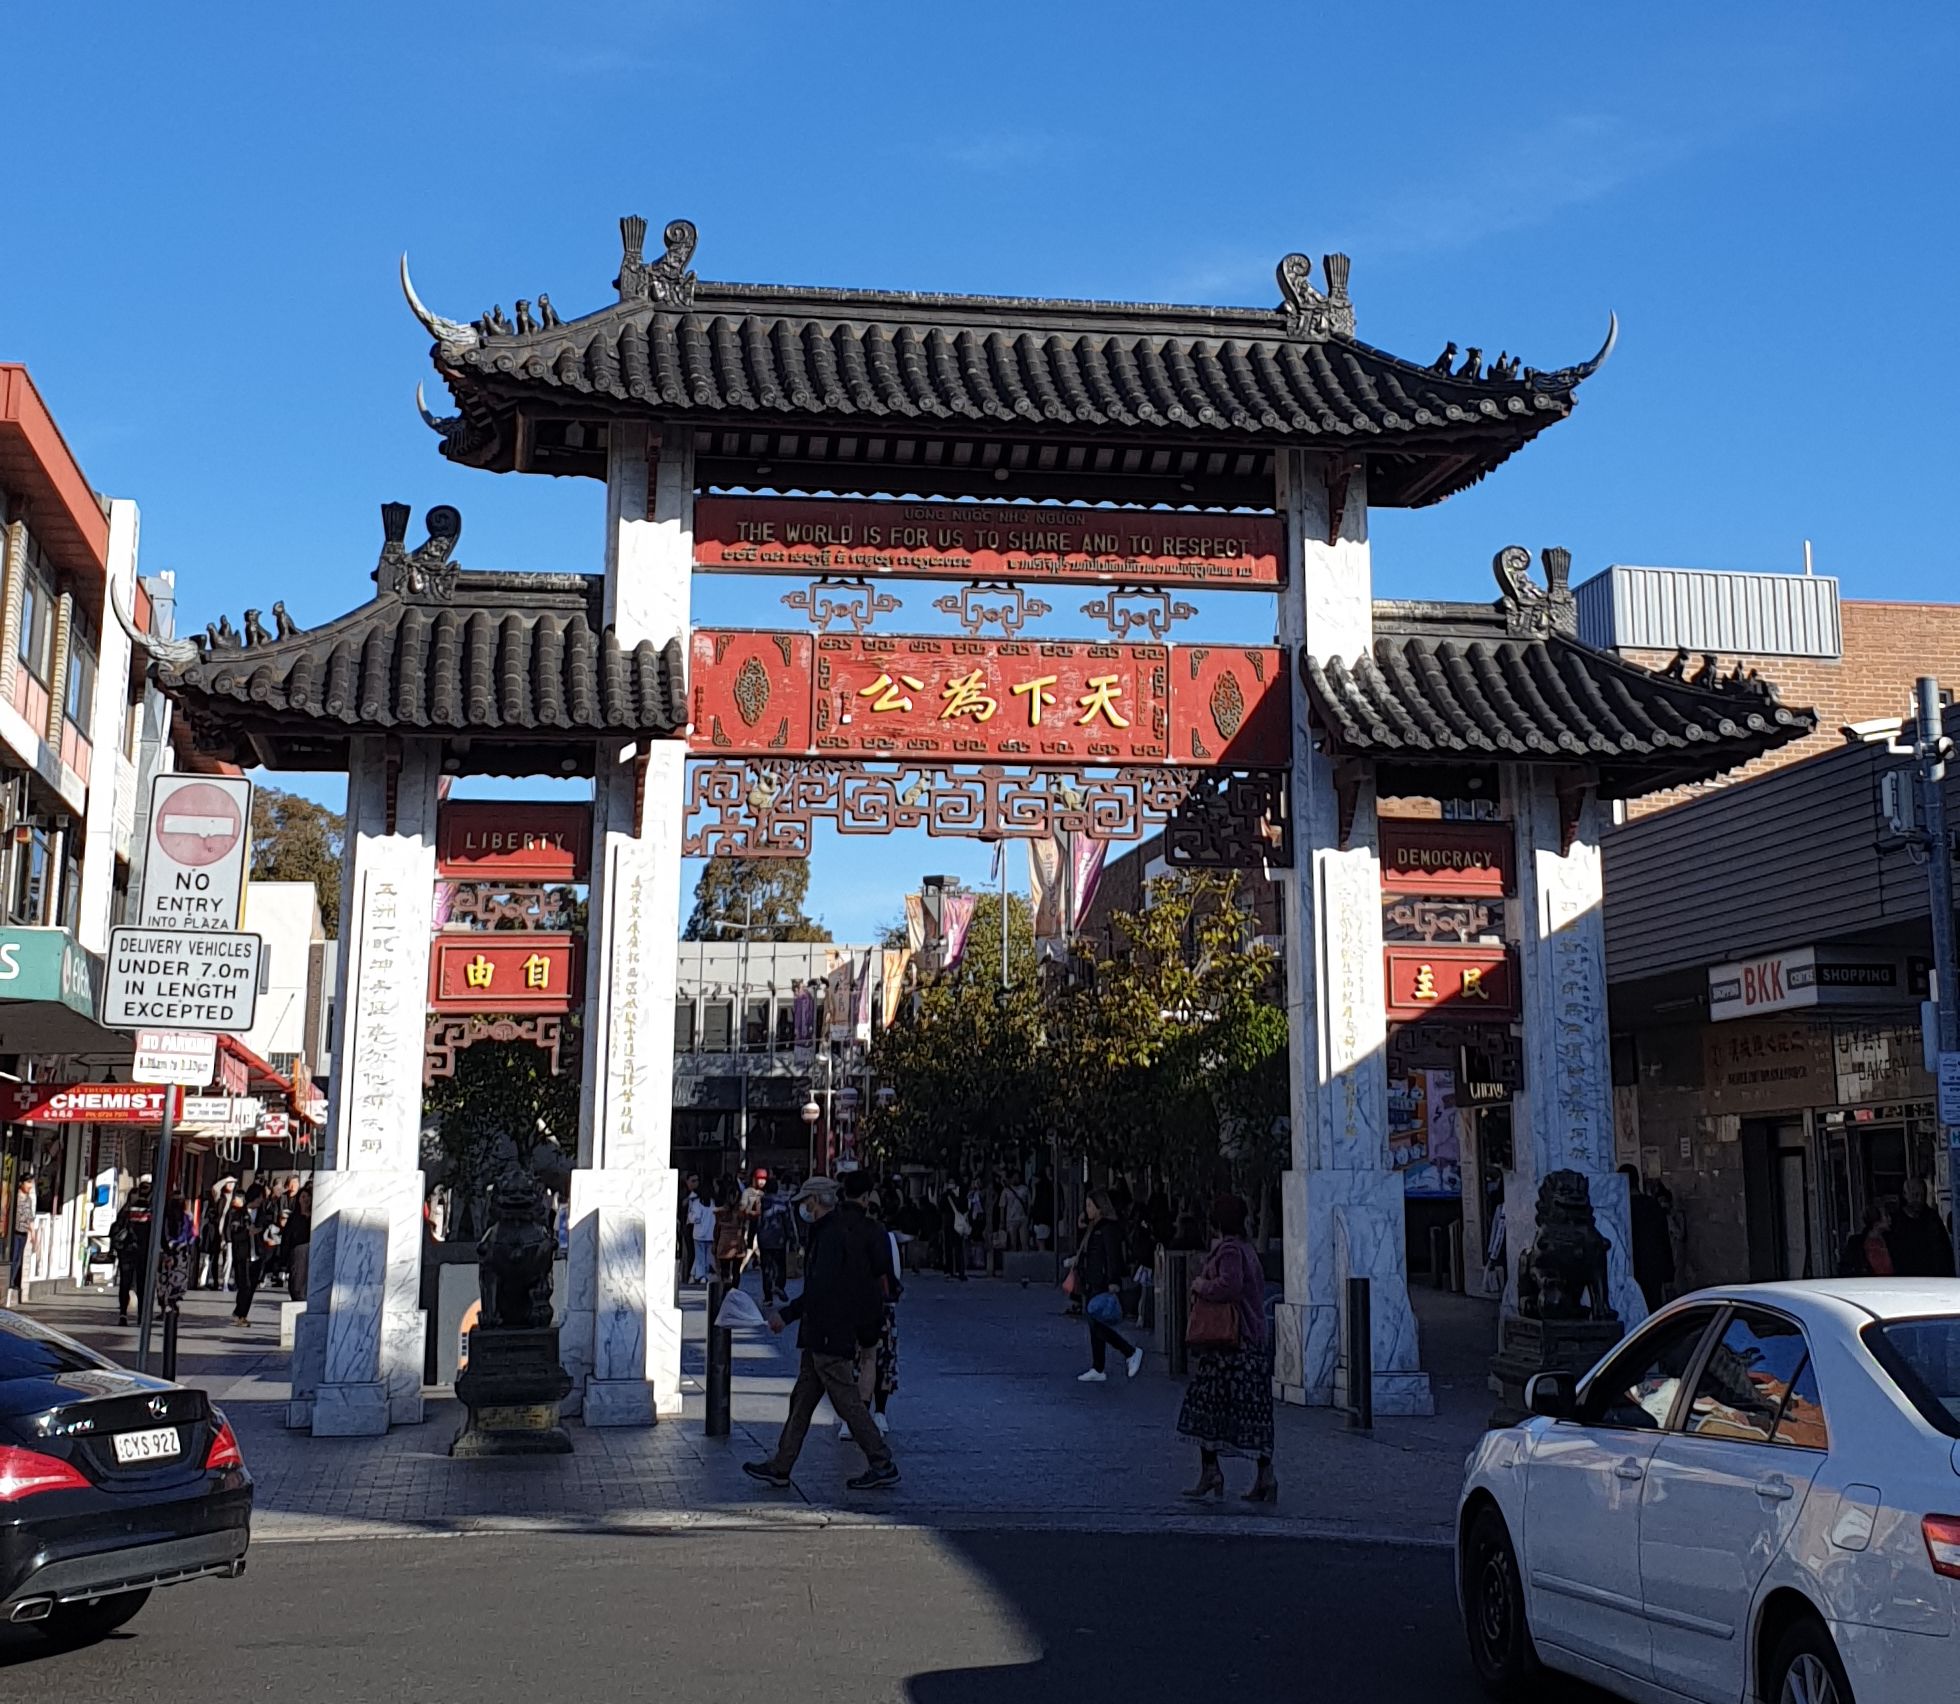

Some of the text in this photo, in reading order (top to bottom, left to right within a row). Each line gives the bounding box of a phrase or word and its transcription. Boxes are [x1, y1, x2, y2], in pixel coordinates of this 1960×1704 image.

[736, 521, 1250, 558] THE WORLD IS FOR US TO SHARE AND TO RESPECT
[465, 831, 565, 850] LIBERTY
[1396, 848, 1493, 868] DEMOCRACY
[176, 872, 210, 891] NO
[157, 896, 224, 913] ENTRY
[147, 916, 229, 930] INTO PLAZA
[120, 937, 252, 958] DELIVERY VEHICLES
[118, 958, 250, 980] UNDER 7.0m
[1822, 968, 1889, 982] SHOPPING
[125, 980, 237, 1000] IN LENGTH
[1743, 960, 1785, 1006] BKK
[124, 1001, 234, 1021] EXCEPTED
[1858, 1056, 1909, 1081] BAKERY
[49, 1093, 166, 1110] CHEMIST
[123, 1436, 150, 1458] CYS
